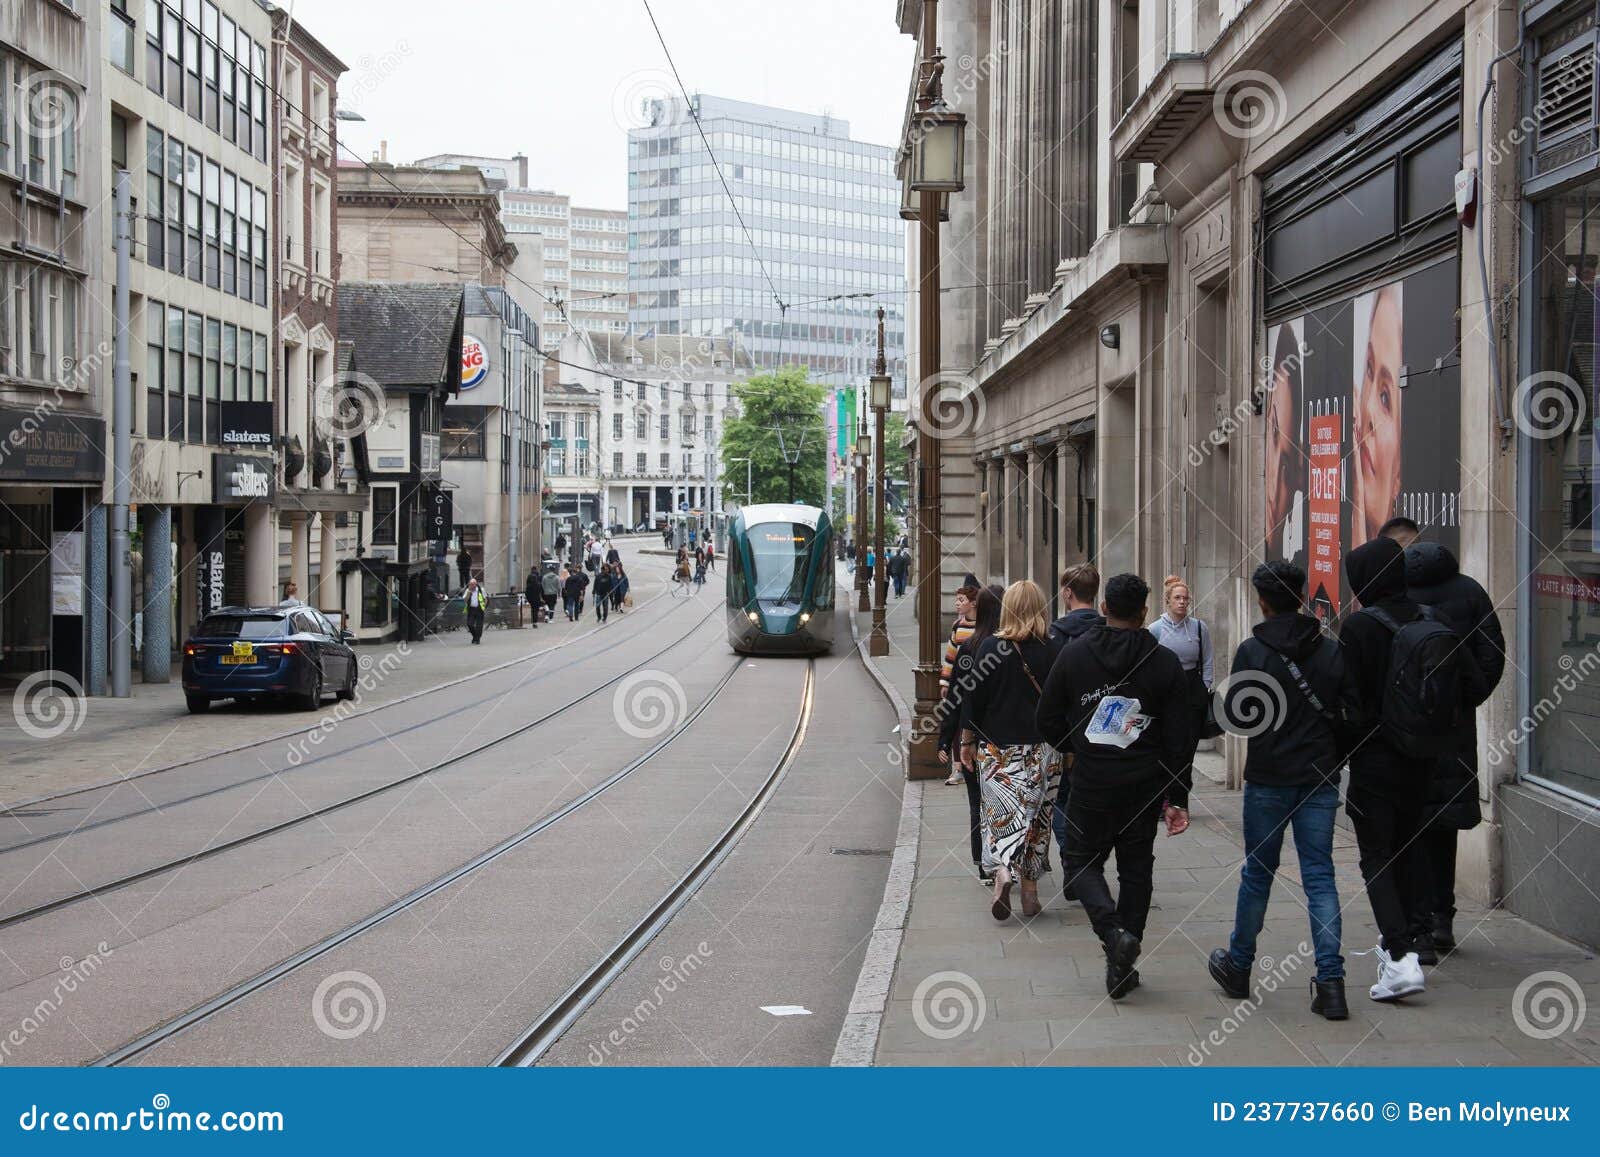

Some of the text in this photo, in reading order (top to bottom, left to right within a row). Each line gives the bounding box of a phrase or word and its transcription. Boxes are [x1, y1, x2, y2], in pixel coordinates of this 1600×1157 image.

[462, 343, 480, 355] GER
[462, 352, 483, 369] NG
[223, 429, 271, 443] slaters
[232, 463, 268, 497] slaters
[1312, 467, 1321, 500] TO
[1323, 467, 1338, 500] LET
[434, 495, 444, 536] GIGI
[210, 551, 225, 614] slater
[1542, 580, 1559, 593] LATTE
